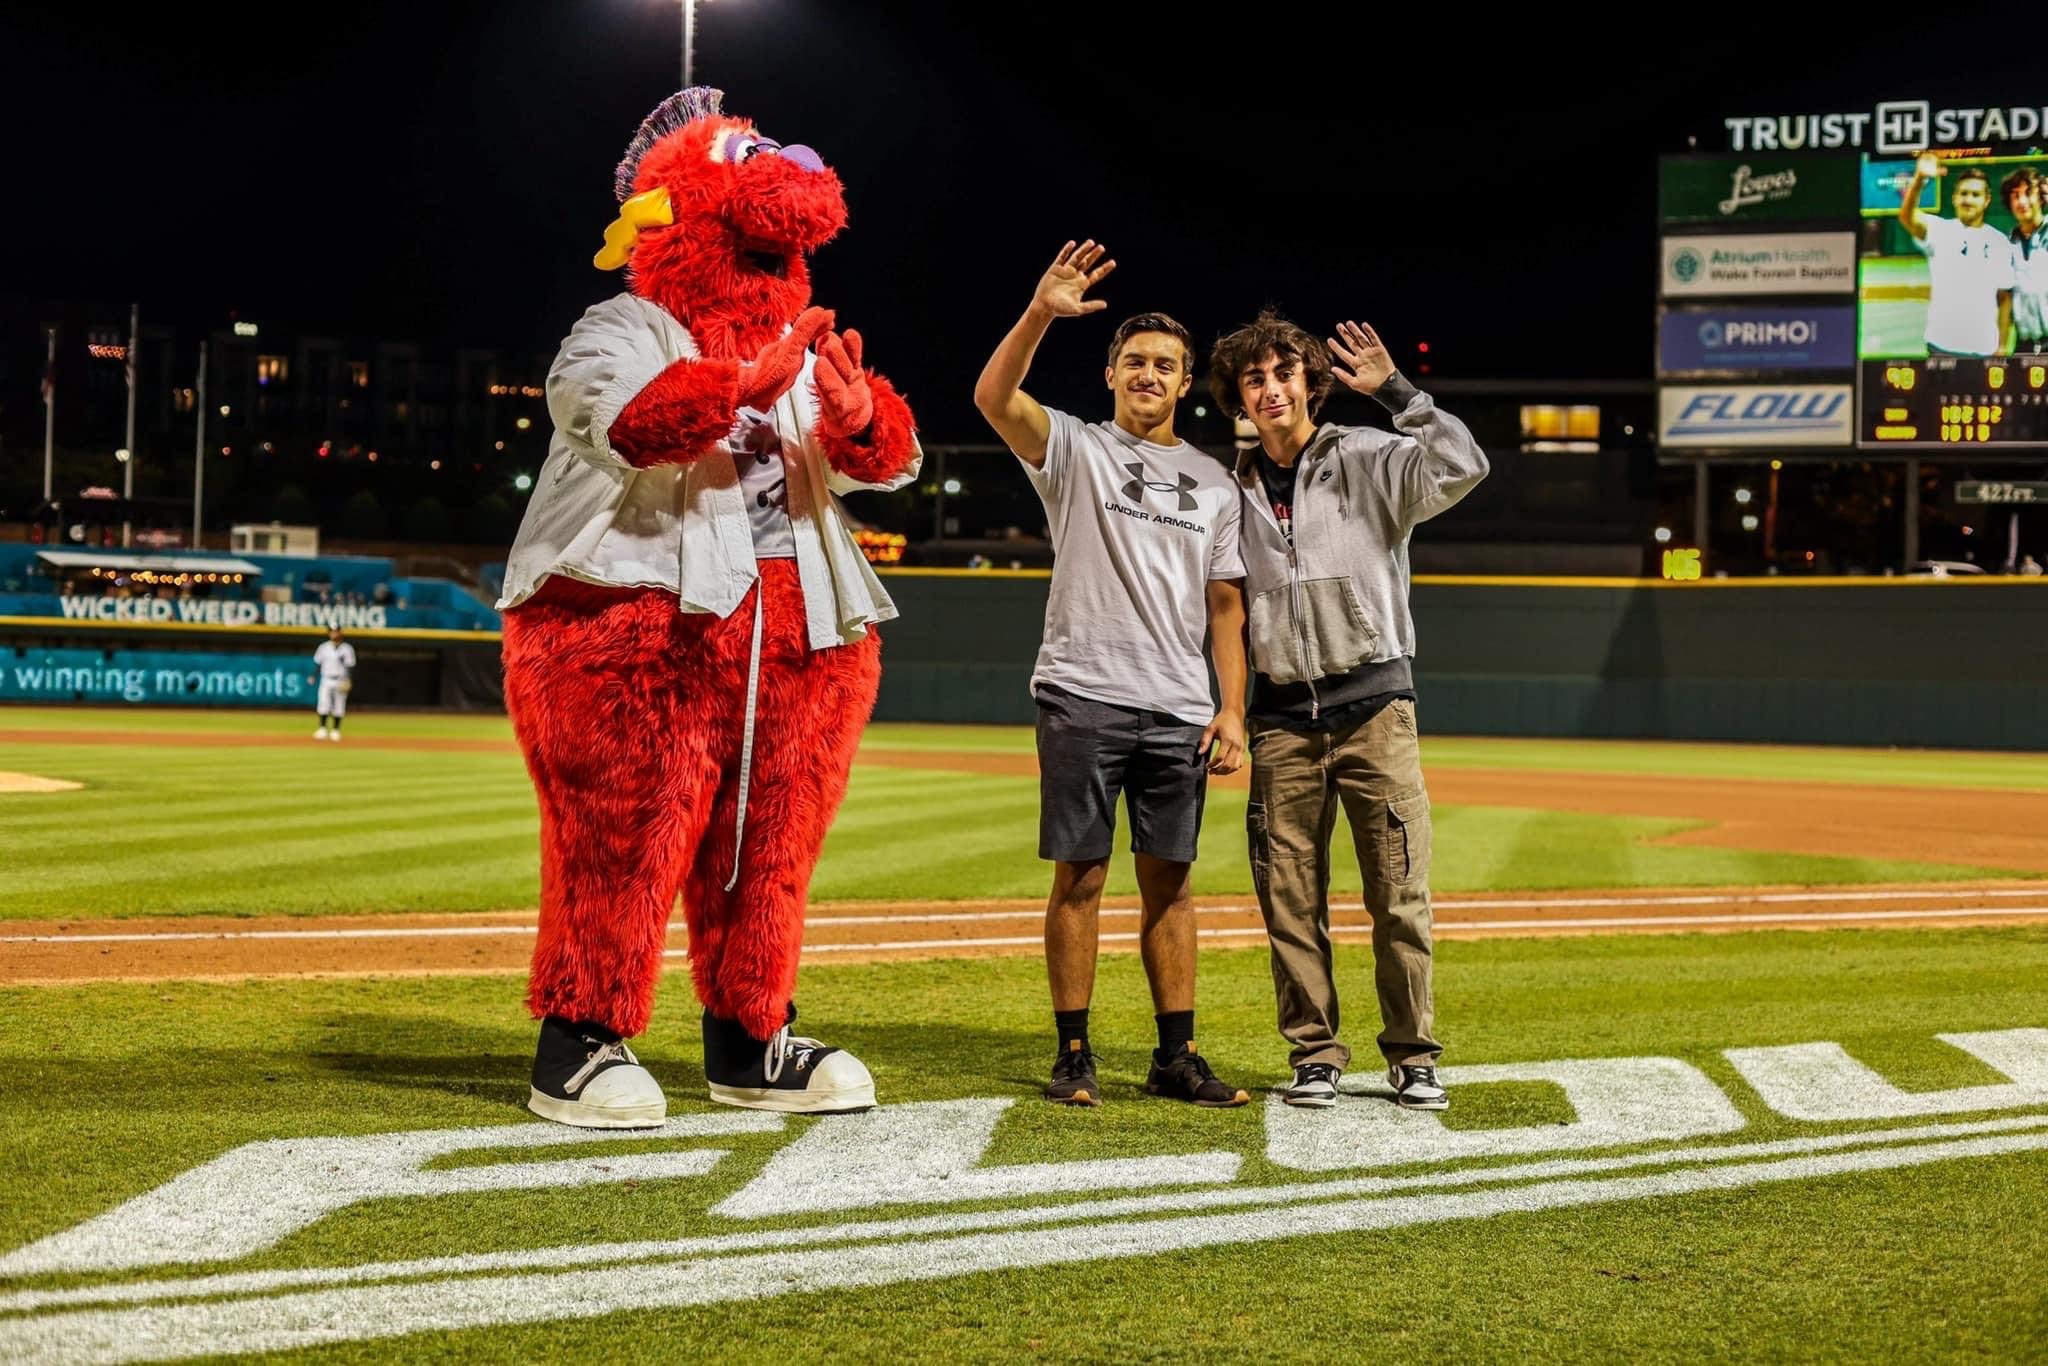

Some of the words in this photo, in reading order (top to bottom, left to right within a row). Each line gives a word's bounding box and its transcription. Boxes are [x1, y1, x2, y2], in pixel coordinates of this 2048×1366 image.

[1724, 112, 1871, 151] TRUIST
[1711, 250, 1772, 265] Atrium
[1725, 320, 1810, 345] PRIMO
[1679, 392, 1847, 420] FLOW
[1105, 501, 1149, 521] UNDER
[1152, 515, 1206, 537] ARMOUR
[60, 595, 174, 622] WICKED
[177, 599, 259, 627] WEED
[263, 602, 387, 629] BREWING
[14, 656, 146, 702] winning
[155, 667, 301, 697] moments
